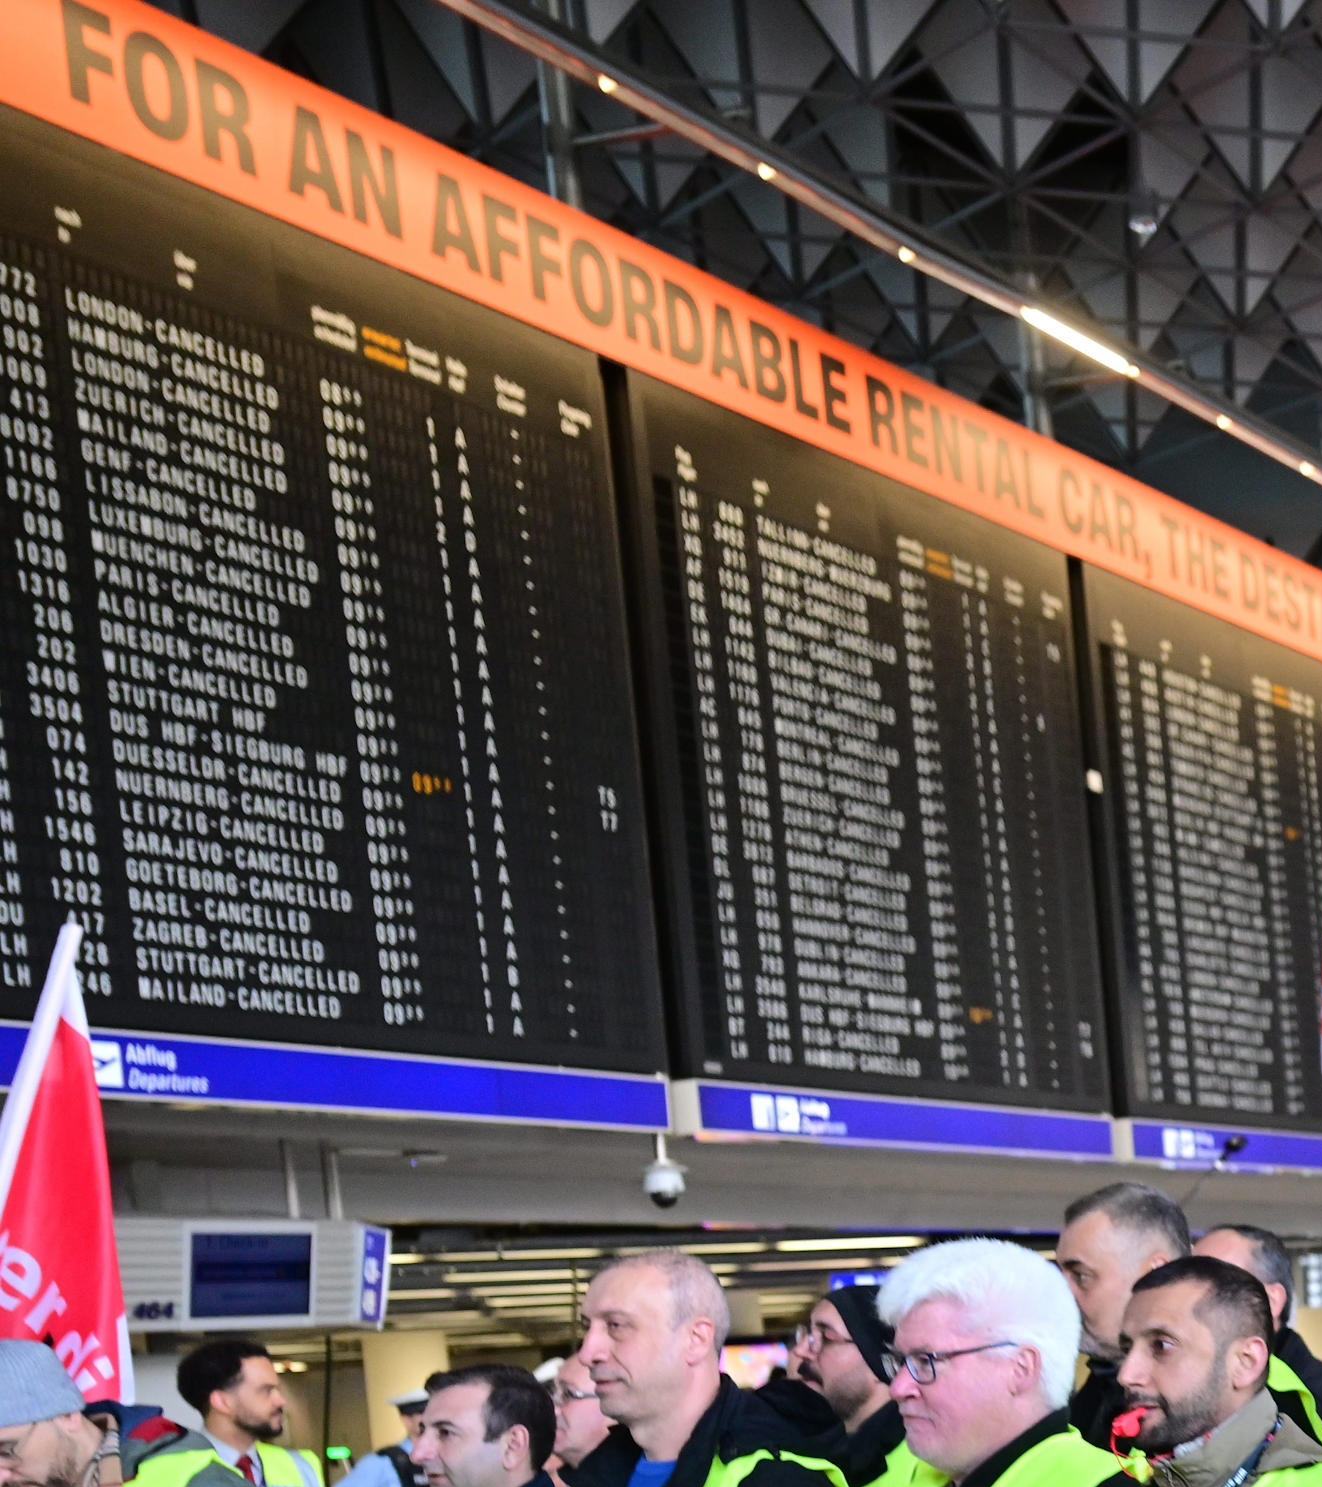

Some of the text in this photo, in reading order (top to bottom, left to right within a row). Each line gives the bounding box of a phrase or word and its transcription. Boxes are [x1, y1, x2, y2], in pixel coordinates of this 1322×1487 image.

[57, 3, 257, 179] FOR
[288, 104, 405, 243] AN
[431, 172, 853, 435] AFFORDABLE
[866, 374, 1046, 520] RENTAL
[1160, 515, 1230, 599] THE
[0, 355, 47, 389] 069
[107, 679, 219, 724] STUTTGART
[109, 708, 149, 738] DUS
[53, 756, 89, 786] 142
[51, 877, 102, 907] 1202
[4, 963, 31, 988] LH
[126, 1043, 178, 1072] Abflug
[129, 1068, 209, 1094] Departures
[0, 1229, 115, 1393] er.di
